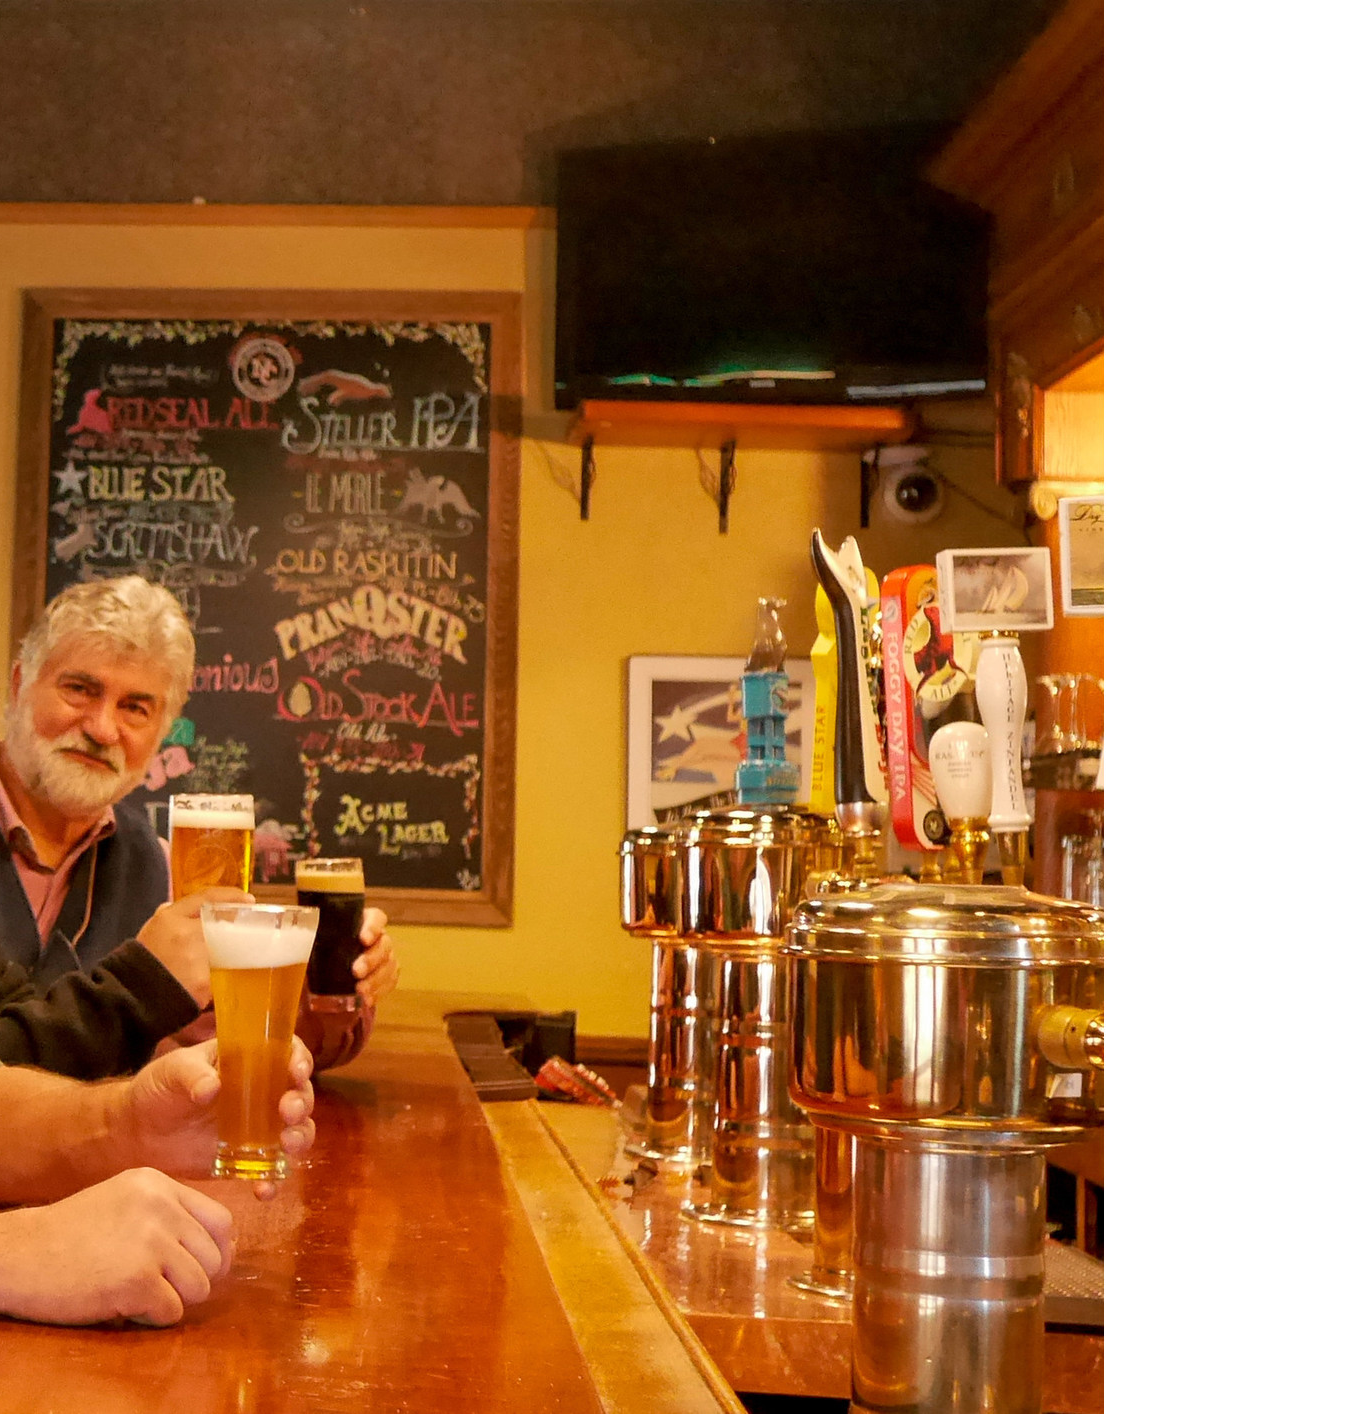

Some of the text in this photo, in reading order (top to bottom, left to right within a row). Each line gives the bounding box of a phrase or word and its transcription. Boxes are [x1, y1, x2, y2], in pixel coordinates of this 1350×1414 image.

[224, 396, 280, 430] ALE
[411, 392, 482, 451] IPA
[88, 466, 236, 503] BLUE STAR
[276, 549, 457, 579] OLD RASPUTIN
[888, 632, 907, 801] FOGGY DAY IPA
[812, 706, 828, 791] BLUE STAR
